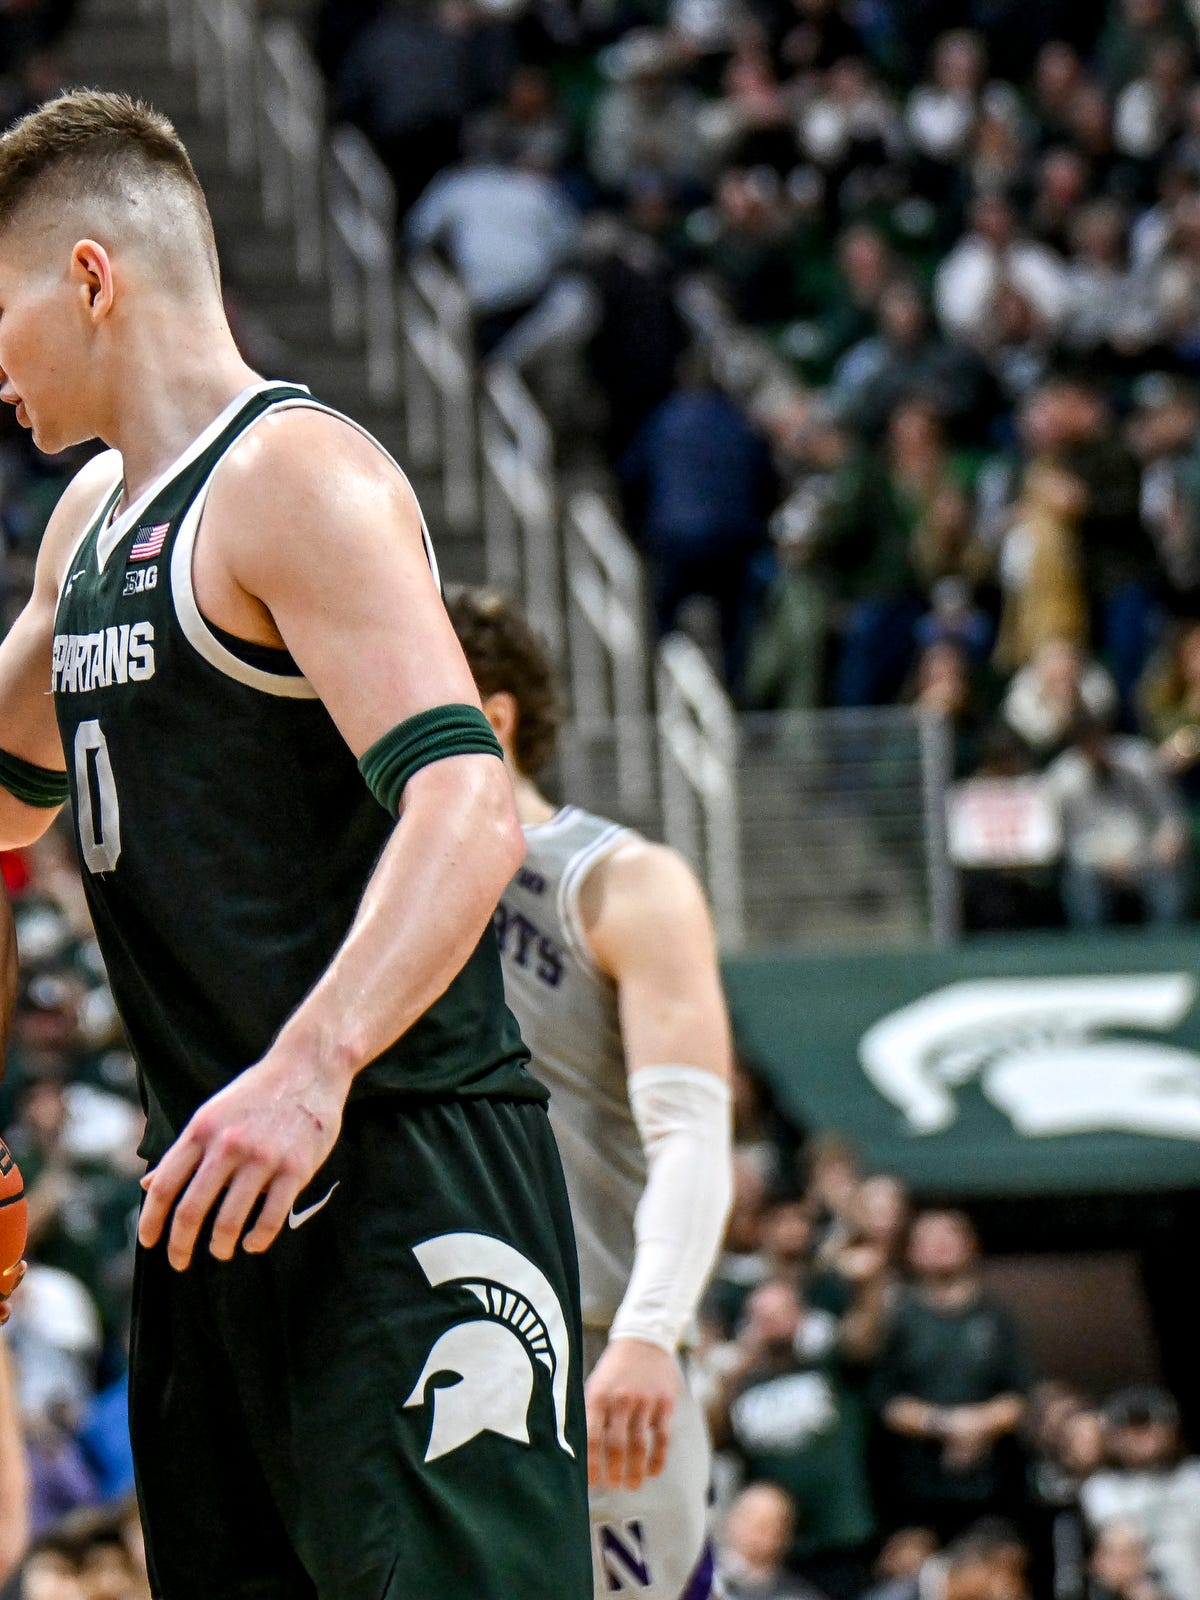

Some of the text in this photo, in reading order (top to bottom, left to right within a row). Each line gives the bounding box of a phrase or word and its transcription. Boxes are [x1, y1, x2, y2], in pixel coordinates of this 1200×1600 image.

[52, 621, 155, 693] PARTANS
[74, 719, 121, 873] 0
[600, 1519, 650, 1591] N
